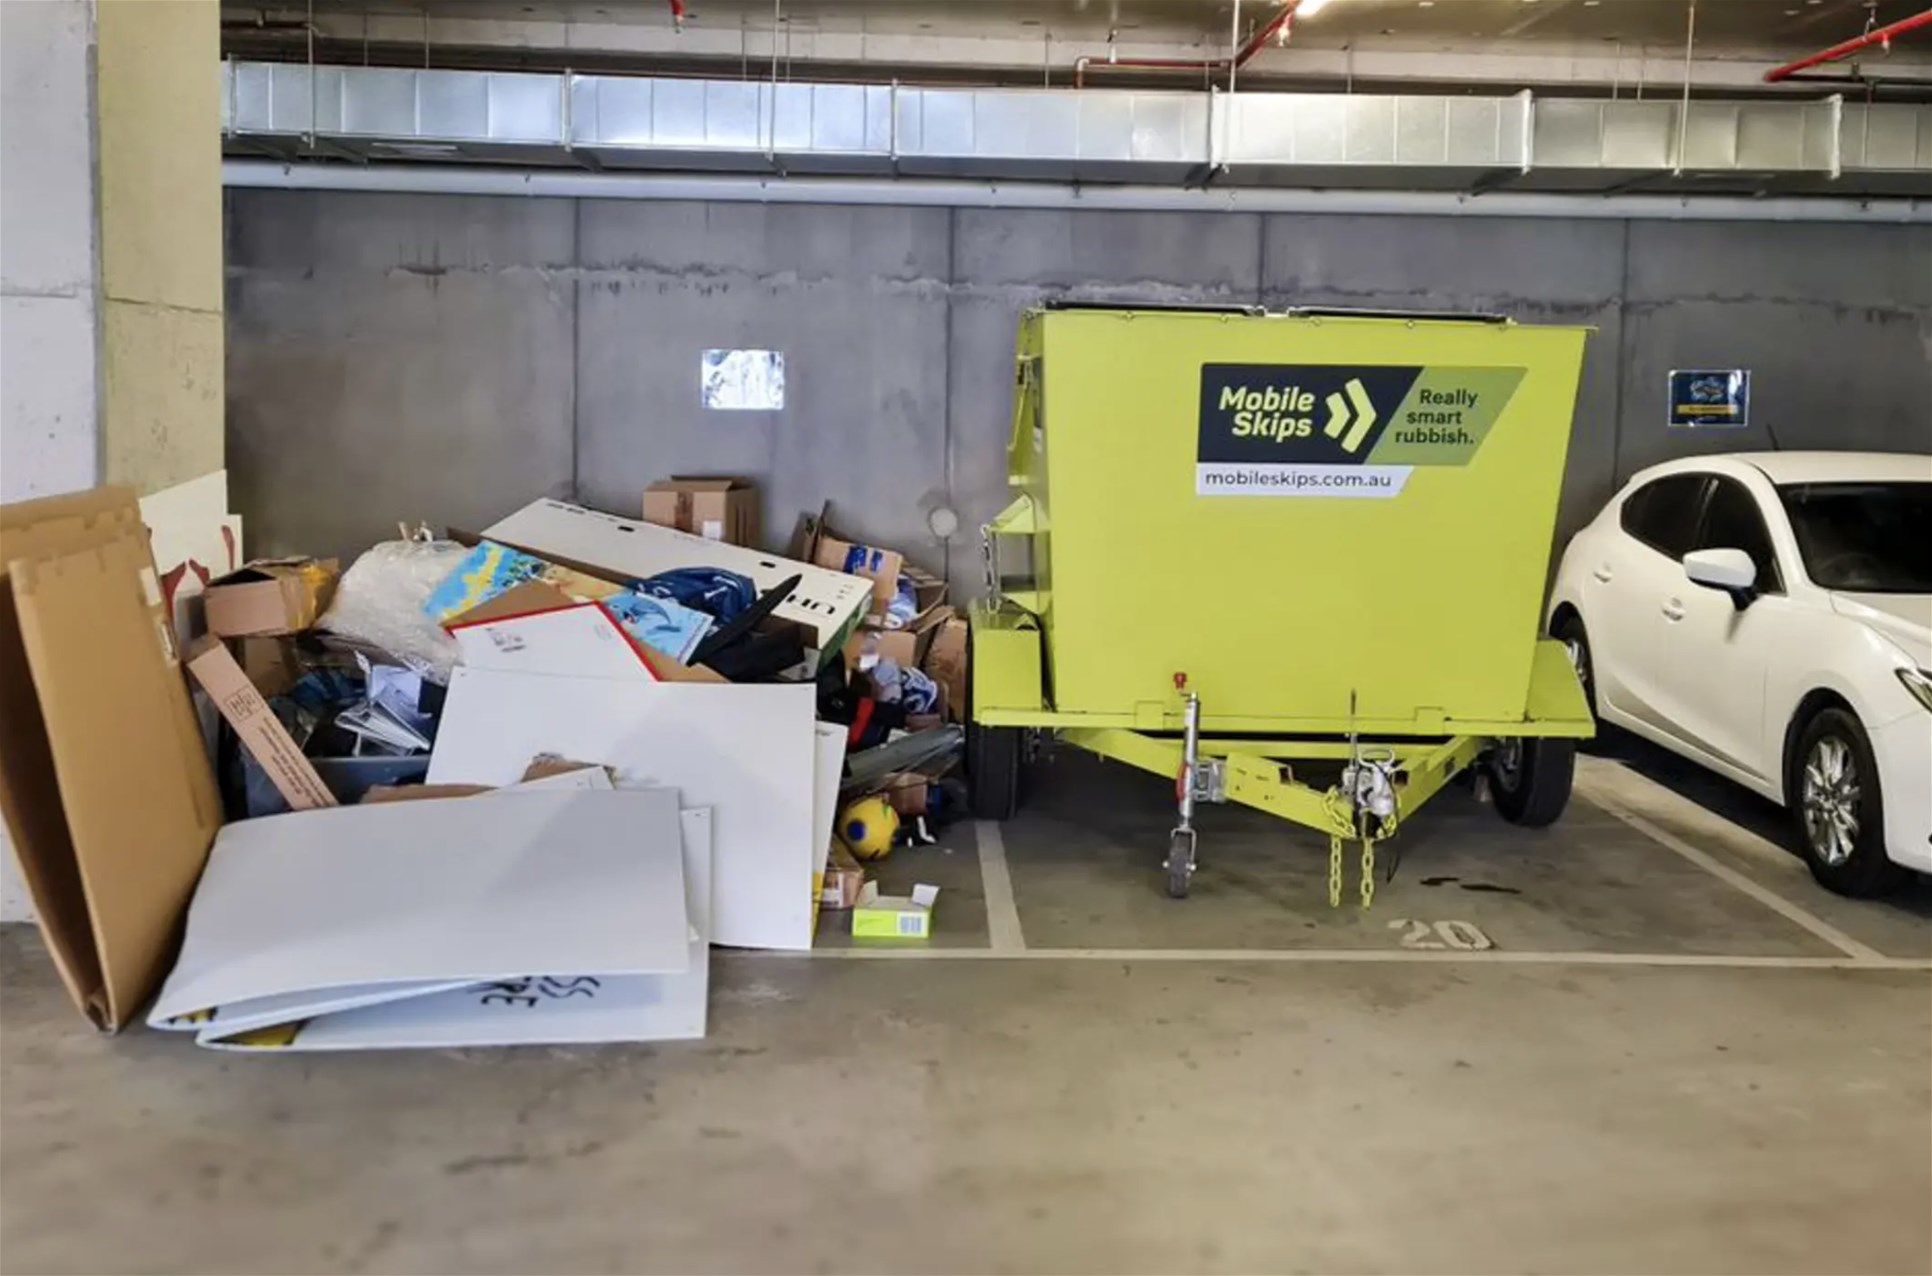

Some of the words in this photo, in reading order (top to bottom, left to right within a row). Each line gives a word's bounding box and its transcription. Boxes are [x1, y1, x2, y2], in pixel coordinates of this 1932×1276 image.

[1218, 386, 1315, 411] Mobile
[1420, 388, 1478, 408] Really
[1231, 411, 1312, 442] Skips
[1406, 410, 1463, 424] smart
[1395, 427, 1475, 444] rubbish.
[1205, 471, 1391, 488] mobileskips.com.au
[1387, 919, 1491, 949] 20
